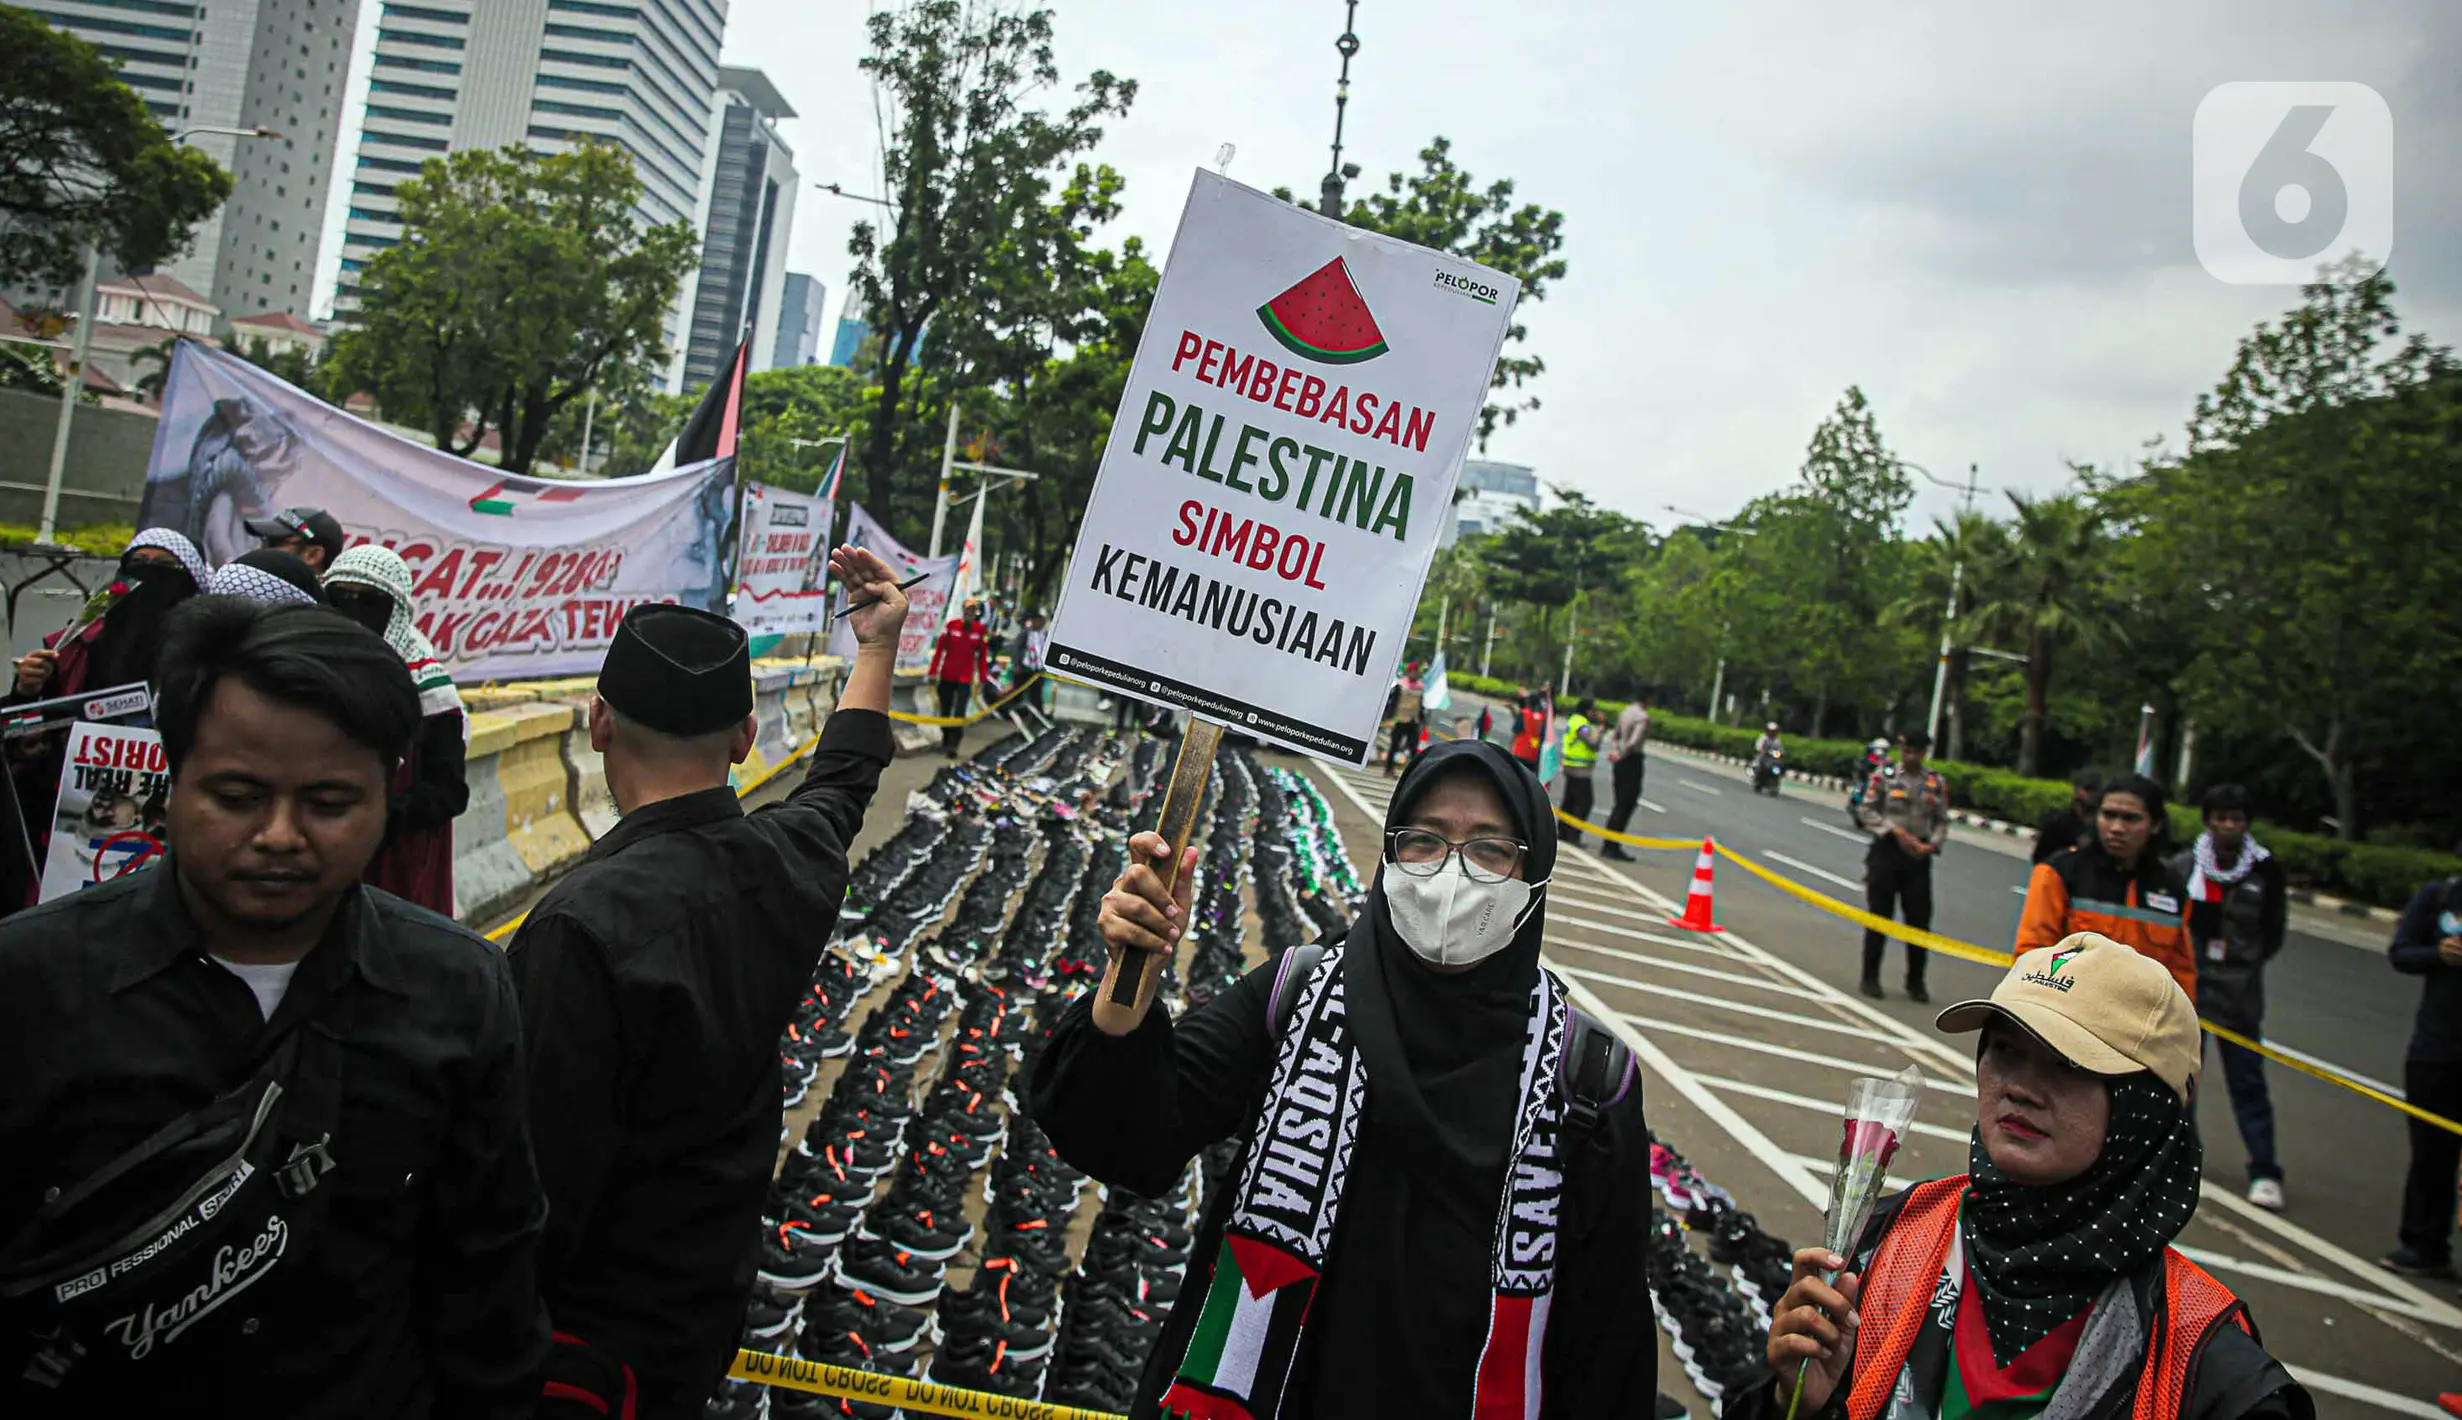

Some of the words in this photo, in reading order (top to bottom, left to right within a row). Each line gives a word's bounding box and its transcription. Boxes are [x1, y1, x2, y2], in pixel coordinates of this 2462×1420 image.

[1433, 282, 1472, 298] KEPEDULIAN
[1435, 268, 1498, 300] PELOPOR
[1172, 330, 1436, 453] PEMBEBASAN
[1132, 390, 1414, 542] PALESTINA
[1172, 500, 1326, 590] SIMBOL
[1090, 544, 1377, 677] KEMANUSIAAN
[1070, 657, 1147, 689] @peloporkepedulianorg
[1161, 685, 1244, 720] @peloporkepedulianorg
[1258, 717, 1354, 756] www.peloporkepedulian.org
[104, 1215, 288, 1360] Yankees
[111, 1215, 200, 1277] FESSIONAL
